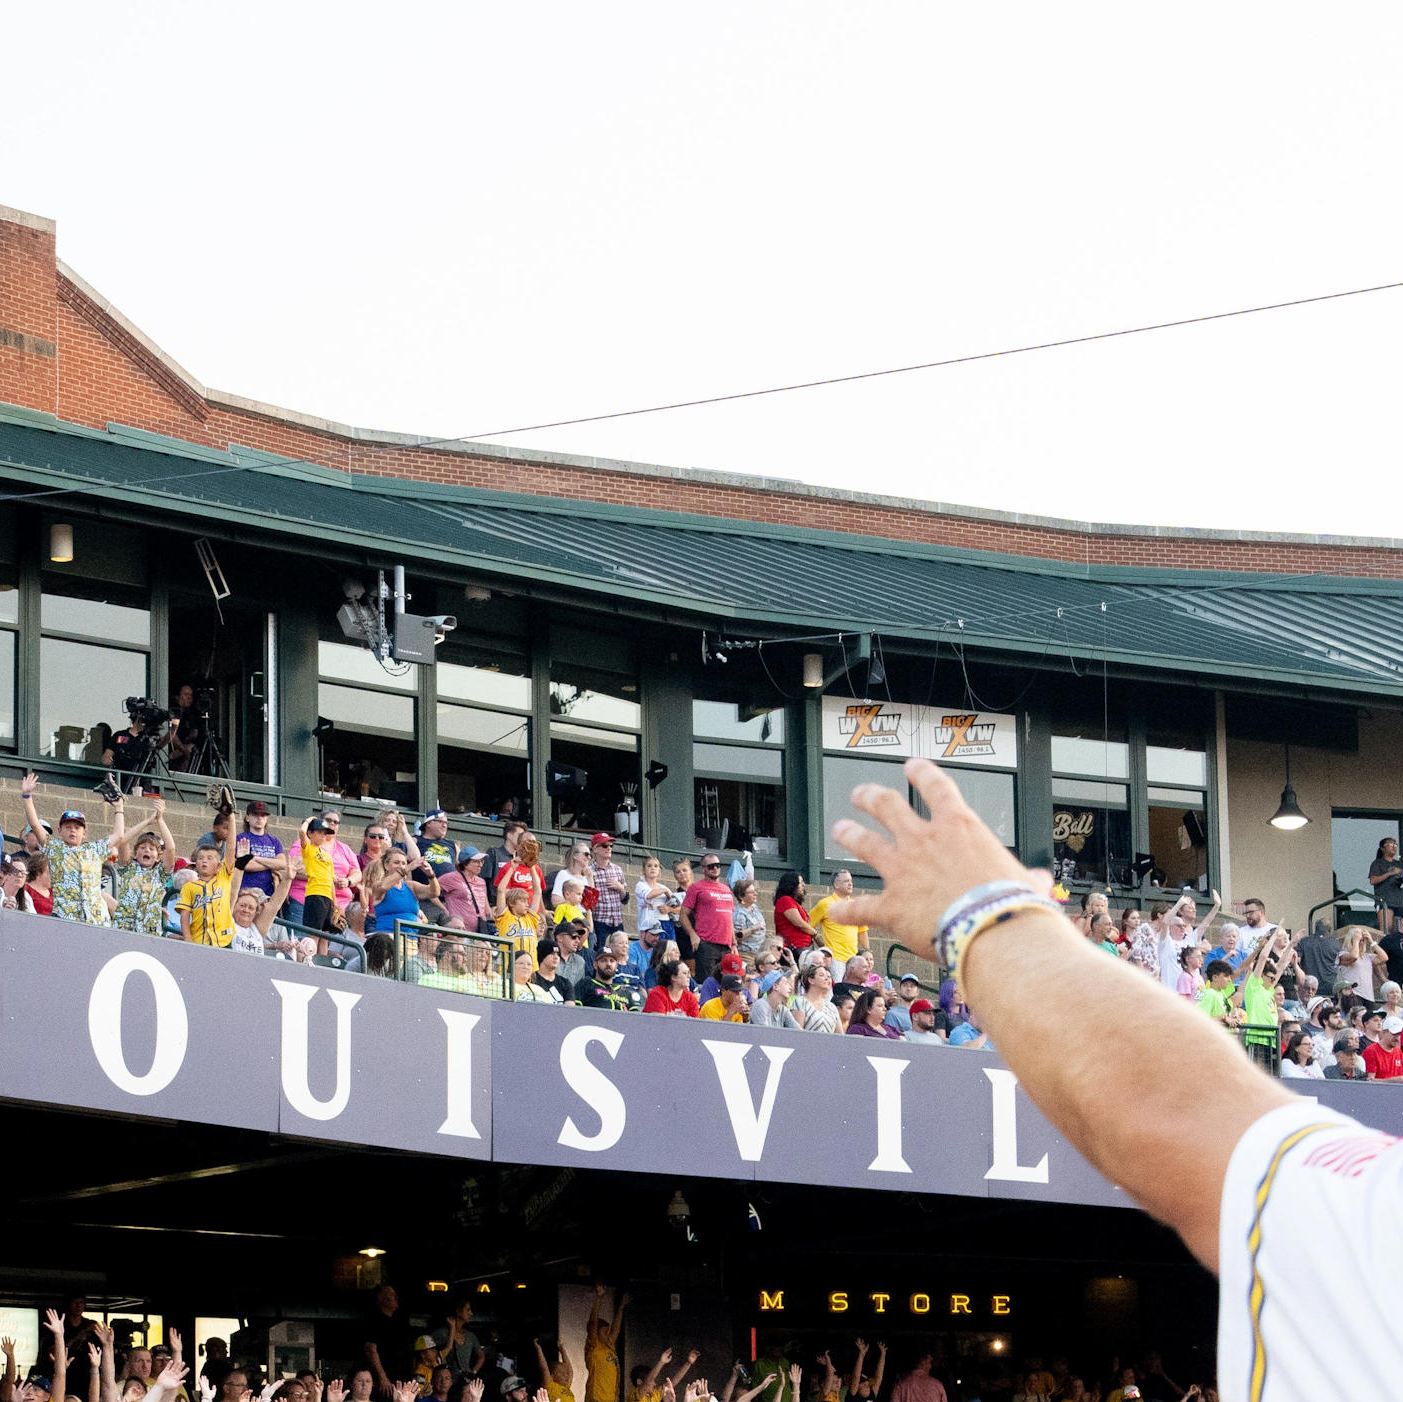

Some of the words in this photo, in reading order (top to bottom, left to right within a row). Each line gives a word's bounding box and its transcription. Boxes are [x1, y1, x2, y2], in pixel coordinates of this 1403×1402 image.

[1053, 812, 1094, 843] Ball
[759, 1290, 786, 1311] M
[827, 1292, 1012, 1316] STORE
